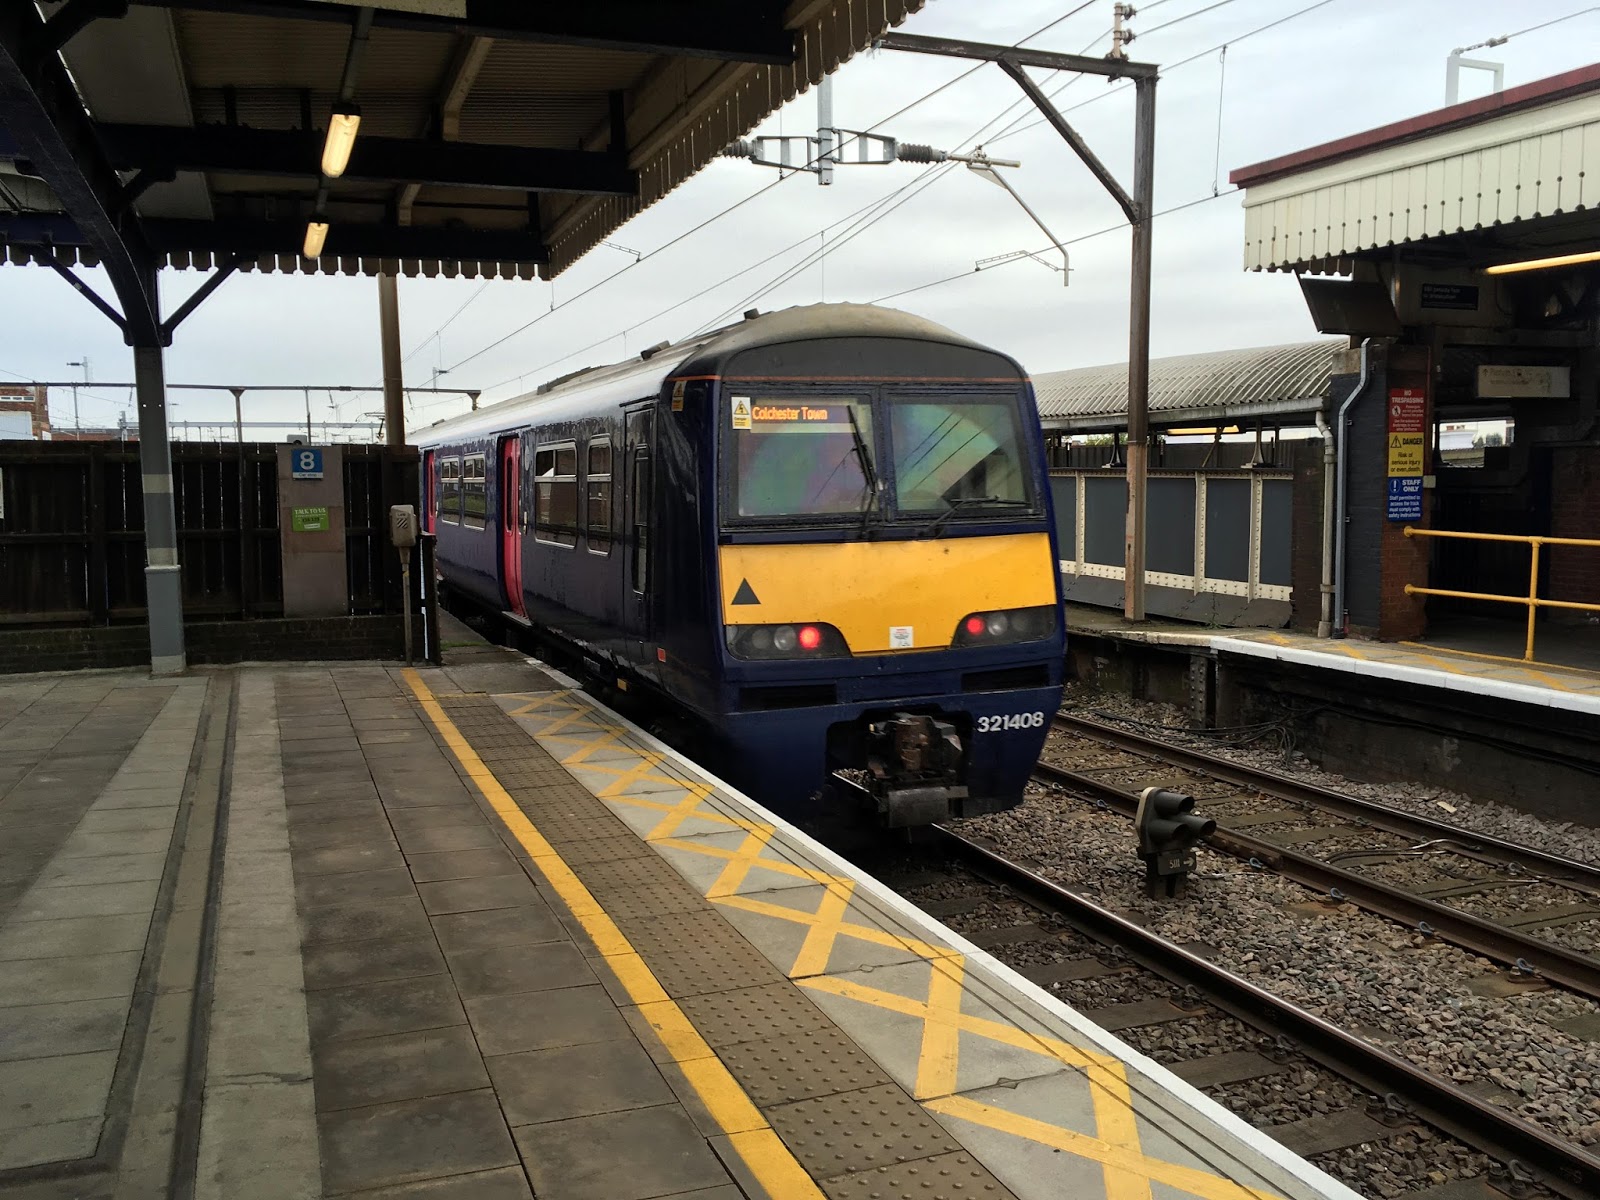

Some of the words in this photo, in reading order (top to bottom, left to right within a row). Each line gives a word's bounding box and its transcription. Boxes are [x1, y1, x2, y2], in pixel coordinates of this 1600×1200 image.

[752, 407, 800, 420] Colchester
[801, 407, 828, 420] Town
[300, 451, 315, 470] 8
[977, 711, 1045, 733] 321408
